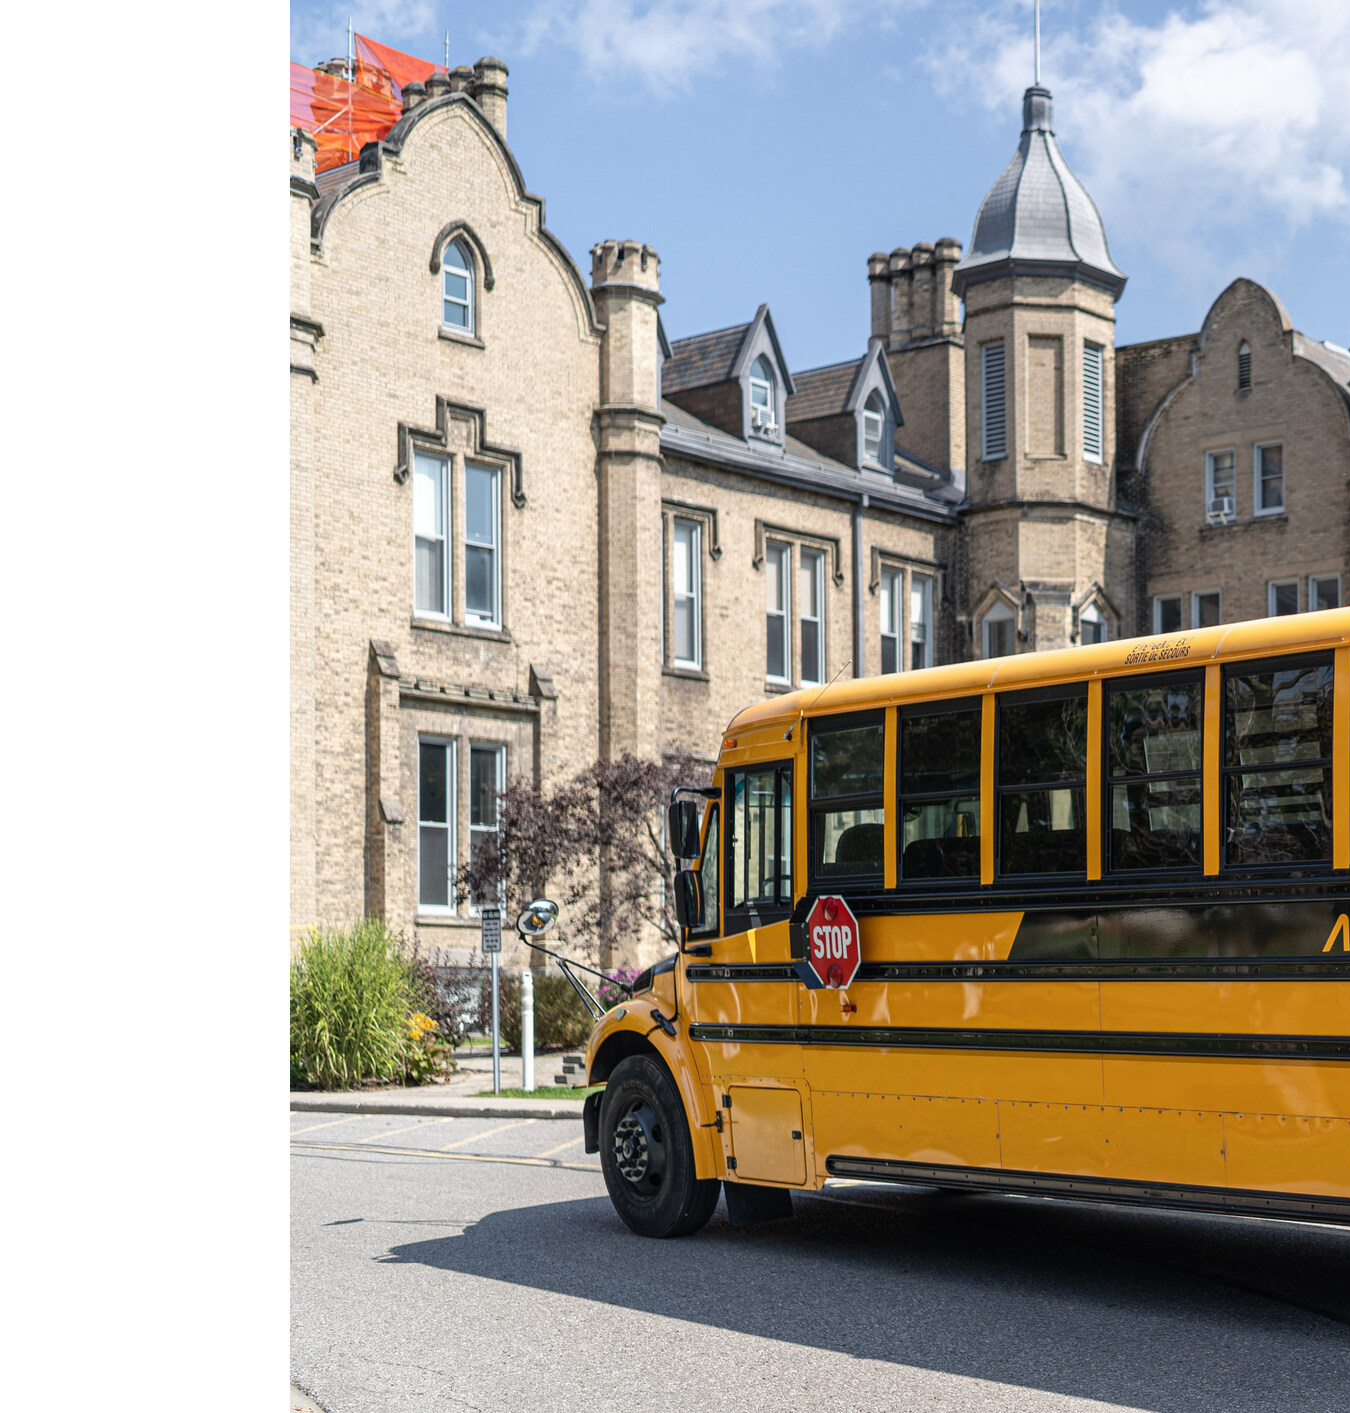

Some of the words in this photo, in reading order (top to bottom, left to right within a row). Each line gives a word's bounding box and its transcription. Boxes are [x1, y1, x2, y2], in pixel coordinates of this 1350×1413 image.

[1125, 651, 1150, 665] SORTIE
[1158, 645, 1191, 660] SECOURS
[813, 925, 852, 959] STOP
